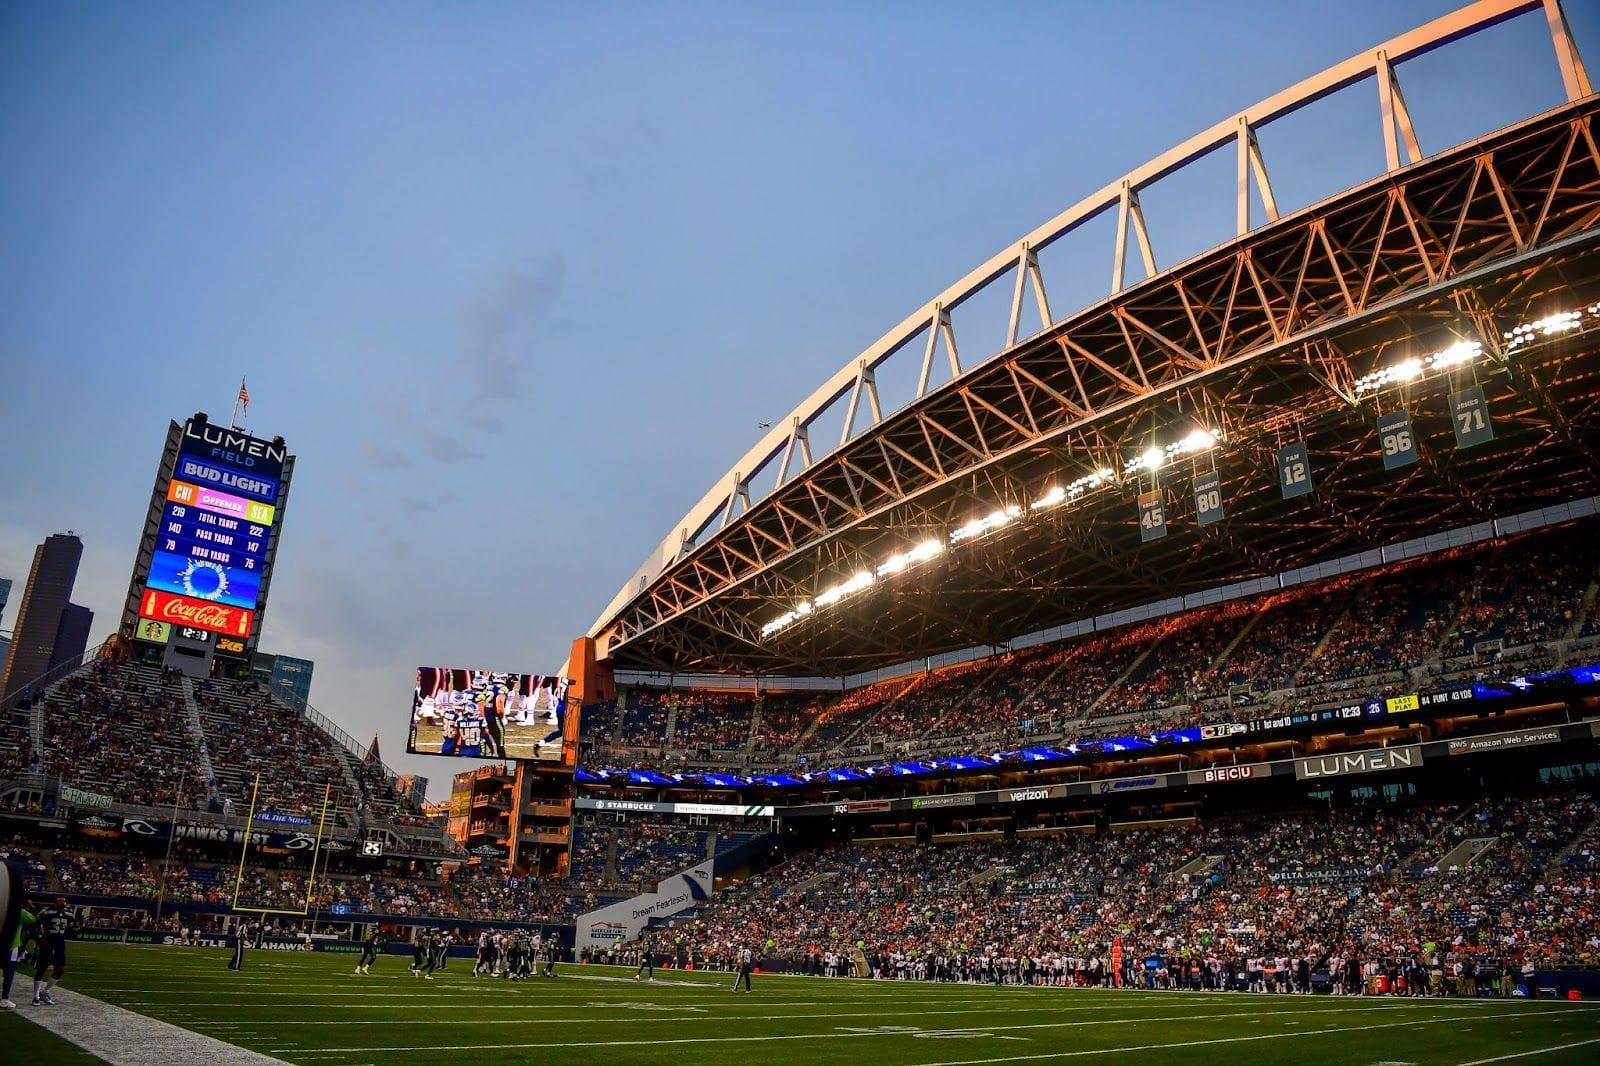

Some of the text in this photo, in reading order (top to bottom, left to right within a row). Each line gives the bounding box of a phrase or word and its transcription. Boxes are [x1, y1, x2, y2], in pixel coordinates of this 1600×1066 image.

[1457, 409, 1485, 434] 71
[186, 422, 285, 463] LUMEN
[1383, 431, 1411, 456] 96
[212, 447, 255, 467] FIELD
[184, 462, 271, 495] BUD LIGHT
[1284, 463, 1306, 485] 12
[175, 484, 193, 501] CHI
[202, 495, 242, 512] OFFENSE
[1198, 490, 1220, 513] 80
[172, 505, 186, 517] 219
[198, 512, 217, 526] TOTAL
[249, 525, 264, 537] 222
[250, 505, 268, 521] SEA
[1142, 508, 1163, 530] 45
[168, 522, 182, 534] 140
[195, 528, 211, 541] PASS
[247, 541, 259, 553] 147
[165, 539, 176, 551] 79
[244, 557, 255, 569] 75
[183, 628, 208, 641] 12:33
[1394, 696, 1412, 704] LAST
[1451, 691, 1460, 700] 43
[1460, 690, 1473, 700] YDS
[1341, 706, 1361, 718] 12:33
[1394, 703, 1412, 711] PLAY
[1272, 718, 1284, 728] and
[1284, 717, 1292, 726] 10
[1450, 731, 1558, 749] aws Amazon Web Services
[1303, 748, 1411, 777] LUMEN
[1010, 790, 1049, 801] verizon
[607, 802, 655, 810] STARBUCKS
[271, 814, 287, 822] THE
[175, 825, 270, 845] HAWKS NEST
[365, 842, 380, 854] 25
[1274, 872, 1303, 880] DELTA
[335, 905, 345, 915] 12
[632, 893, 689, 919] Dream Fearlessly
[50, 918, 68, 934] 33
